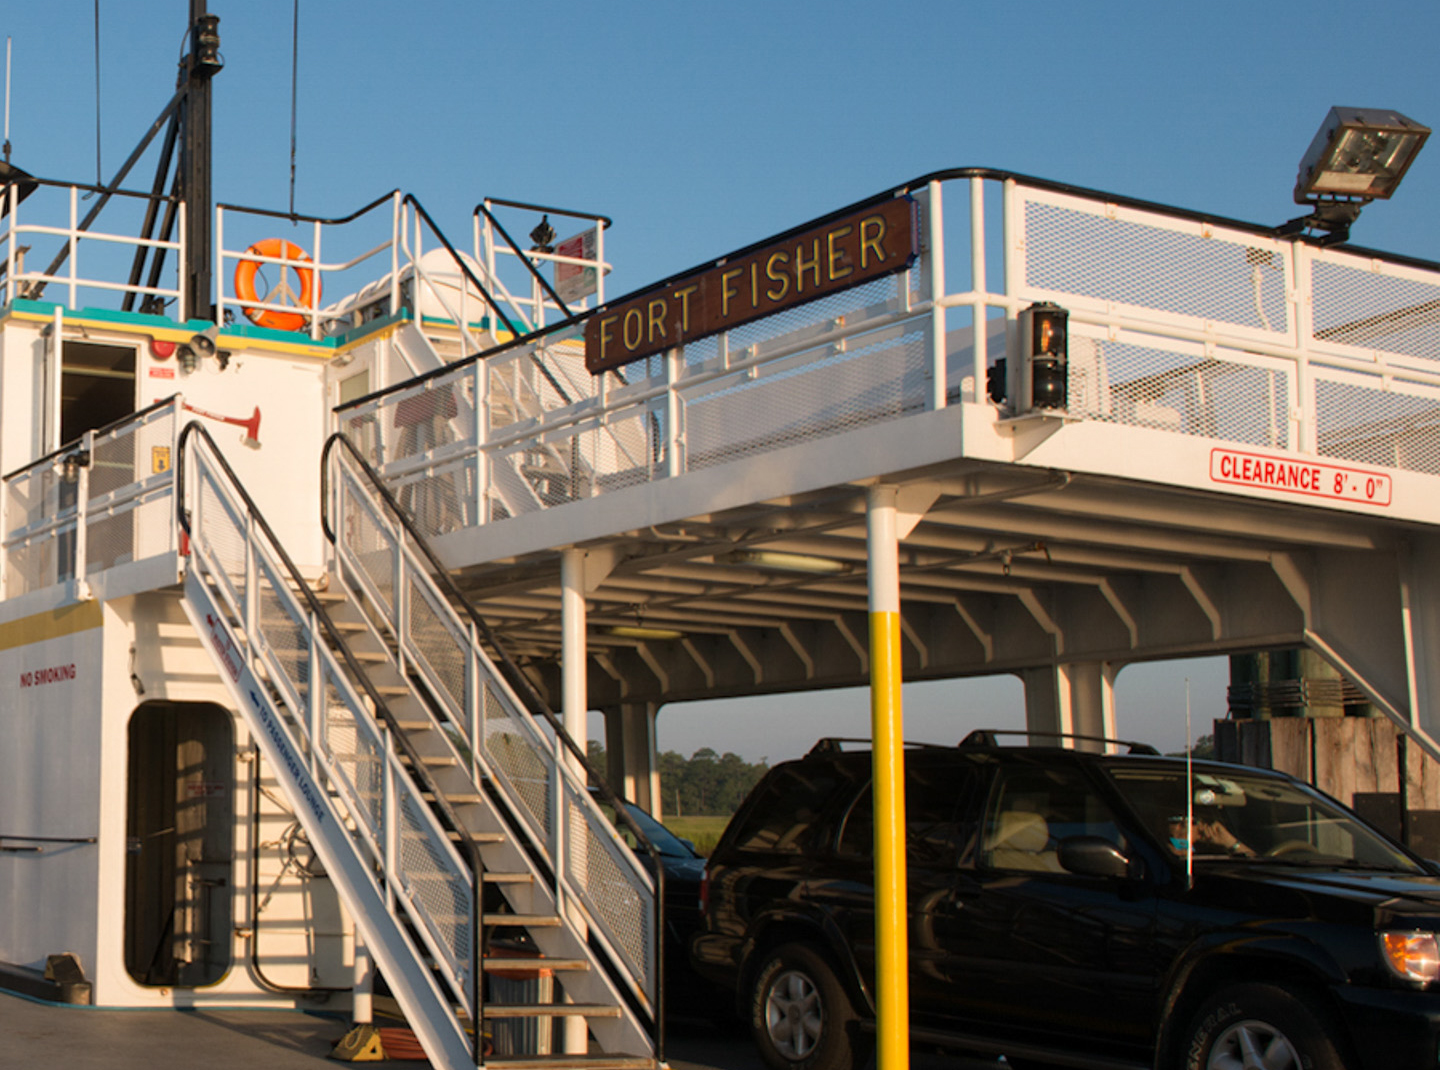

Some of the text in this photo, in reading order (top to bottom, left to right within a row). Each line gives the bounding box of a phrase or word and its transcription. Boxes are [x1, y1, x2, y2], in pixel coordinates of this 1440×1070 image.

[600, 214, 887, 360] FORT FISHER
[1220, 455, 1321, 492] CLEARANCE
[20, 663, 76, 688] NO SMOKING
[266, 720, 301, 781] PASSENGER
[298, 776, 326, 823] LOUNGE
